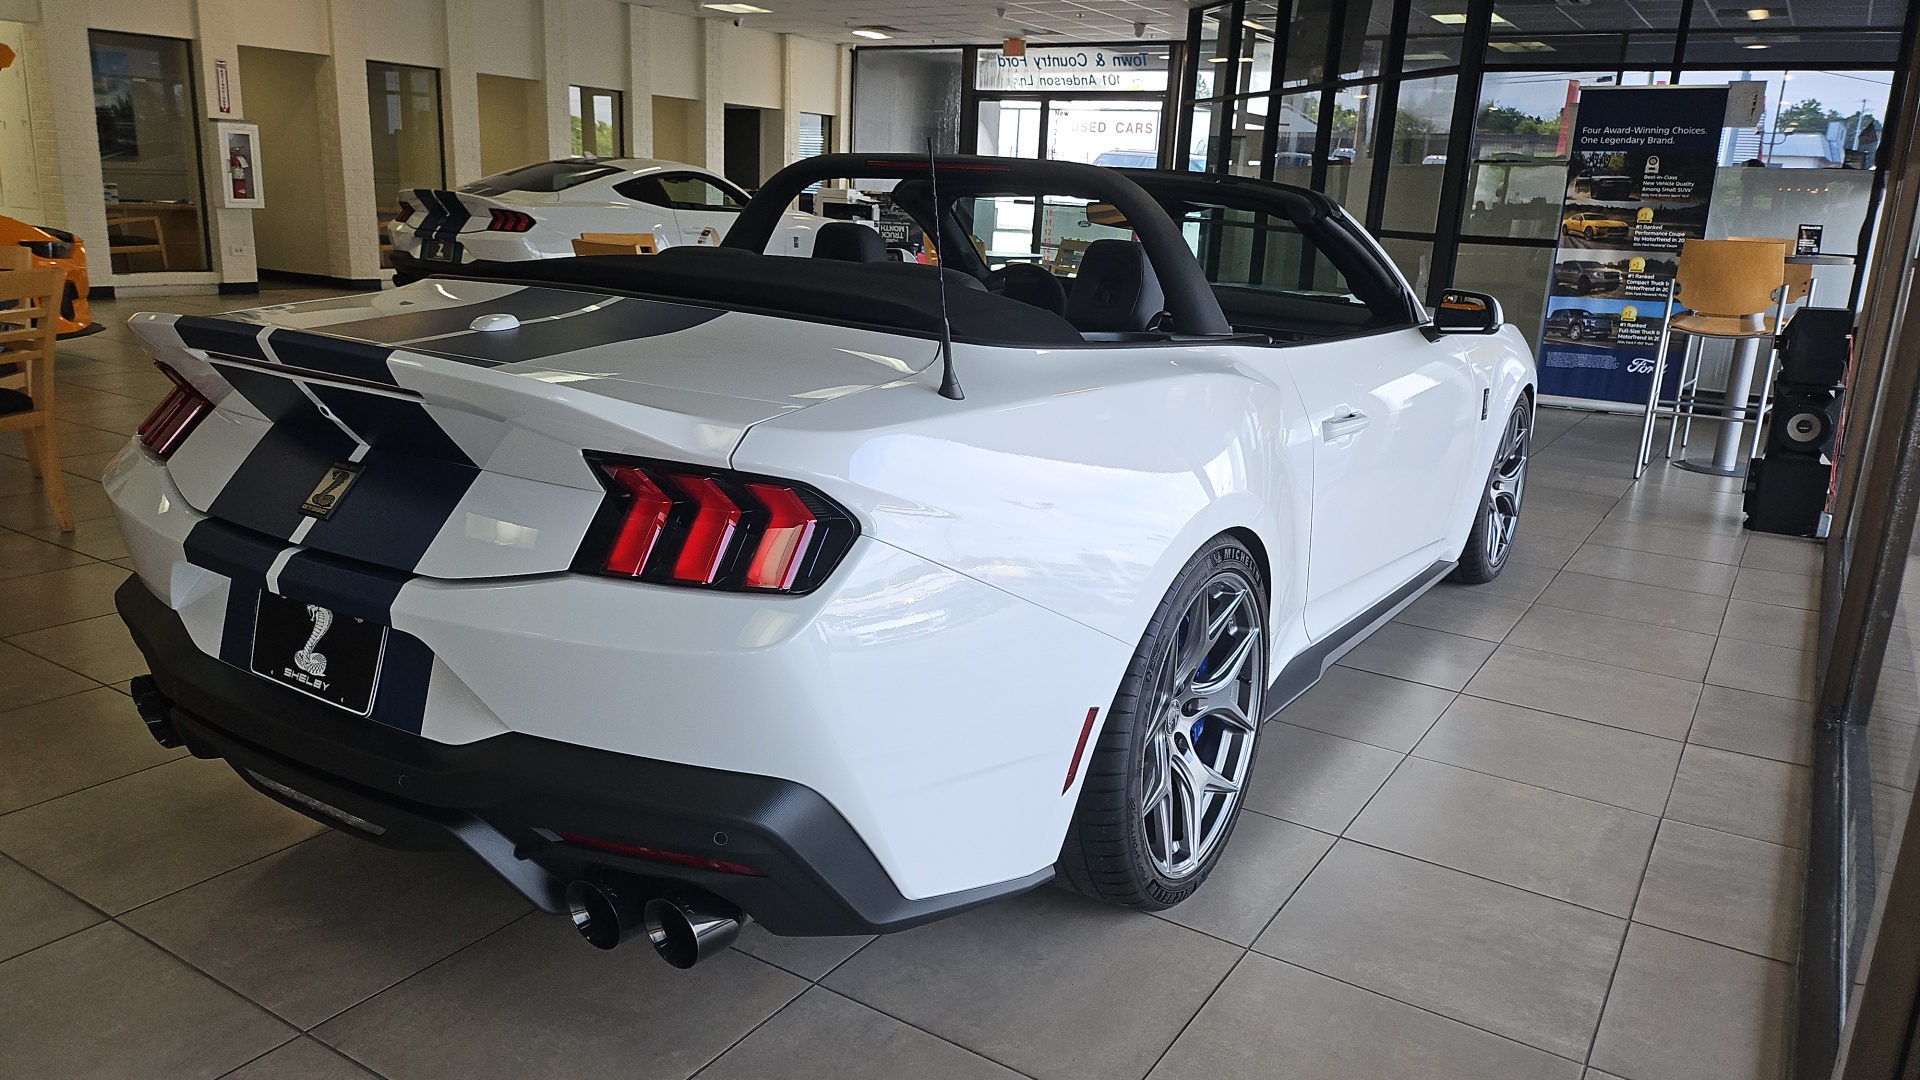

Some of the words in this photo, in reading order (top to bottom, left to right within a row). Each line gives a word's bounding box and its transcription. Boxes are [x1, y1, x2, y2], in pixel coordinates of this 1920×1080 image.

[1071, 121, 1107, 133] USED
[1115, 122, 1153, 134] CARS
[1582, 126, 1602, 135] Four
[1603, 126, 1670, 136] Award-Winning
[1672, 126, 1708, 135] Choices.
[1580, 136, 1599, 145] One
[1600, 136, 1645, 146] Legendary
[1647, 136, 1675, 145] Brand.
[880, 224, 905, 233] MONTH
[881, 231, 904, 239] TRUCK
[1223, 547, 1261, 583] MICHELIN
[283, 667, 331, 692] SHELBY
